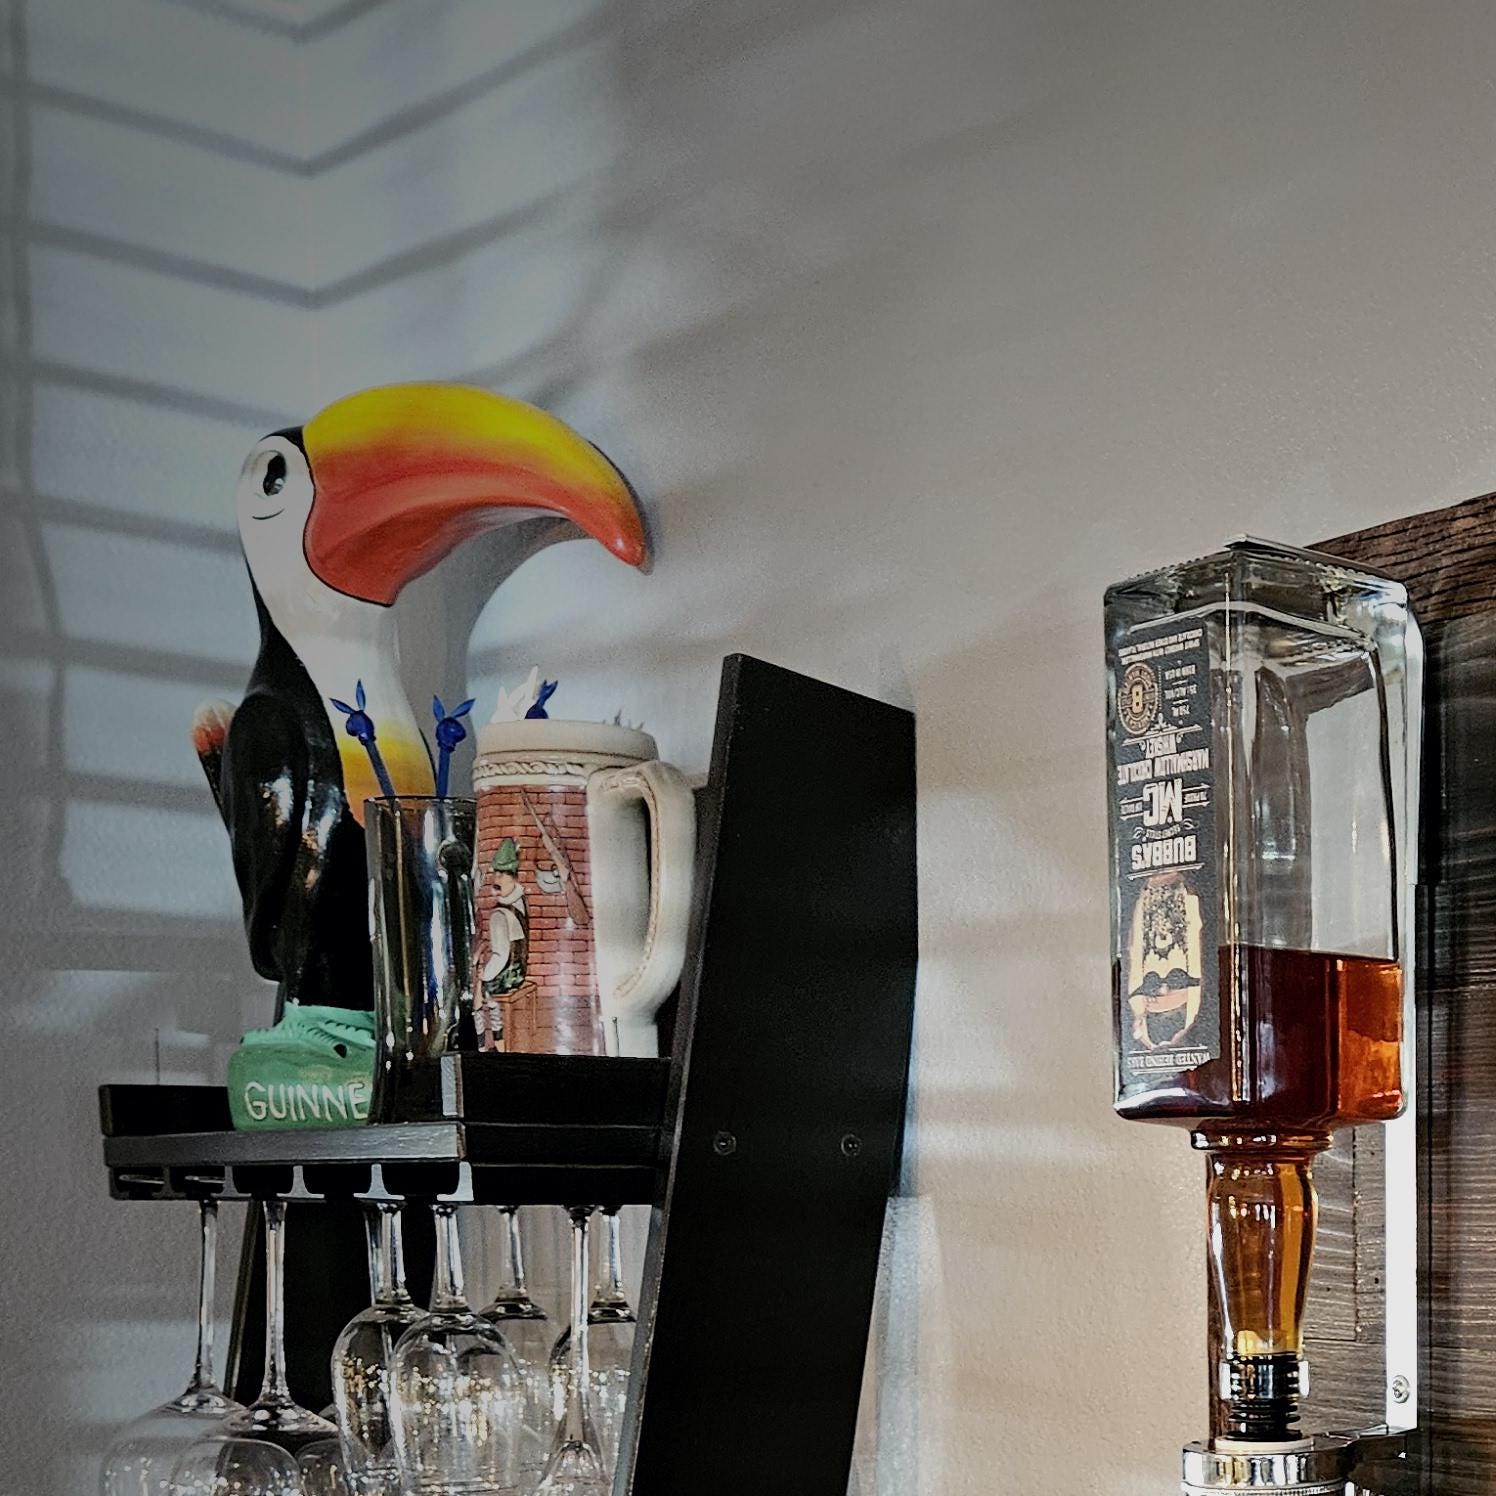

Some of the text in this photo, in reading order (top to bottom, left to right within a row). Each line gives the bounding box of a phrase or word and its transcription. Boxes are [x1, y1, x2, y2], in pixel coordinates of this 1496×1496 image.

[1143, 777, 1183, 828] MC
[1131, 834, 1197, 870] BUBBA'S
[244, 1081, 369, 1122] GUINNE
